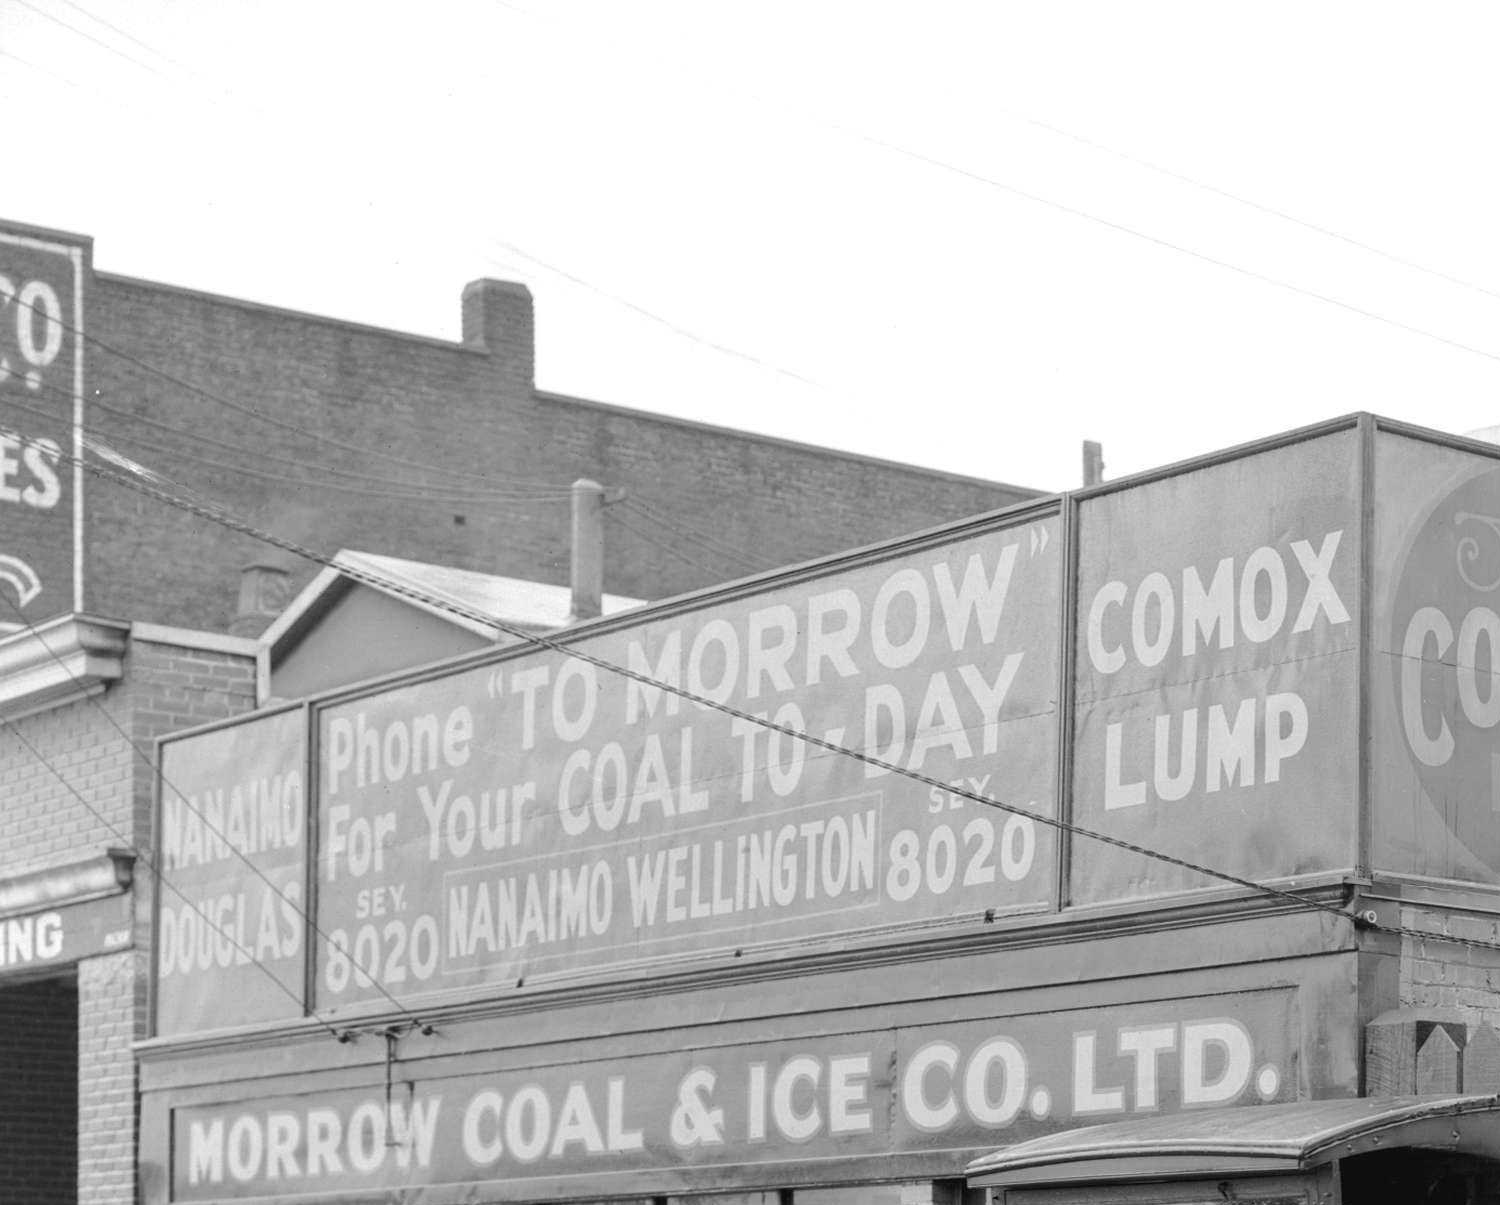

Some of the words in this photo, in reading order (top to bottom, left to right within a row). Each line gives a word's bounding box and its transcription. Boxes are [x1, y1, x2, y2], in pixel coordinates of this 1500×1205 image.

[1086, 529, 1351, 675] COMOX
[326, 805, 398, 882] For
[416, 779, 537, 861] Your
[558, 726, 709, 836] COAL
[327, 704, 475, 795] Phone
[1104, 692, 1310, 811] LUMP
[161, 769, 300, 872] NANAIMO
[885, 814, 1036, 902] 8020
[158, 880, 301, 979] DOUGLAS
[448, 859, 613, 959] NANAIMO
[627, 809, 877, 929] WELLINGTON
[325, 914, 440, 994] 8020
[188, 1098, 441, 1186] MORROW
[461, 1074, 646, 1165] COAL
[670, 1069, 726, 1147] &
[748, 1051, 875, 1141] ICE
[902, 1039, 1051, 1132] CO.
[1073, 1020, 1279, 1113] LTD.
